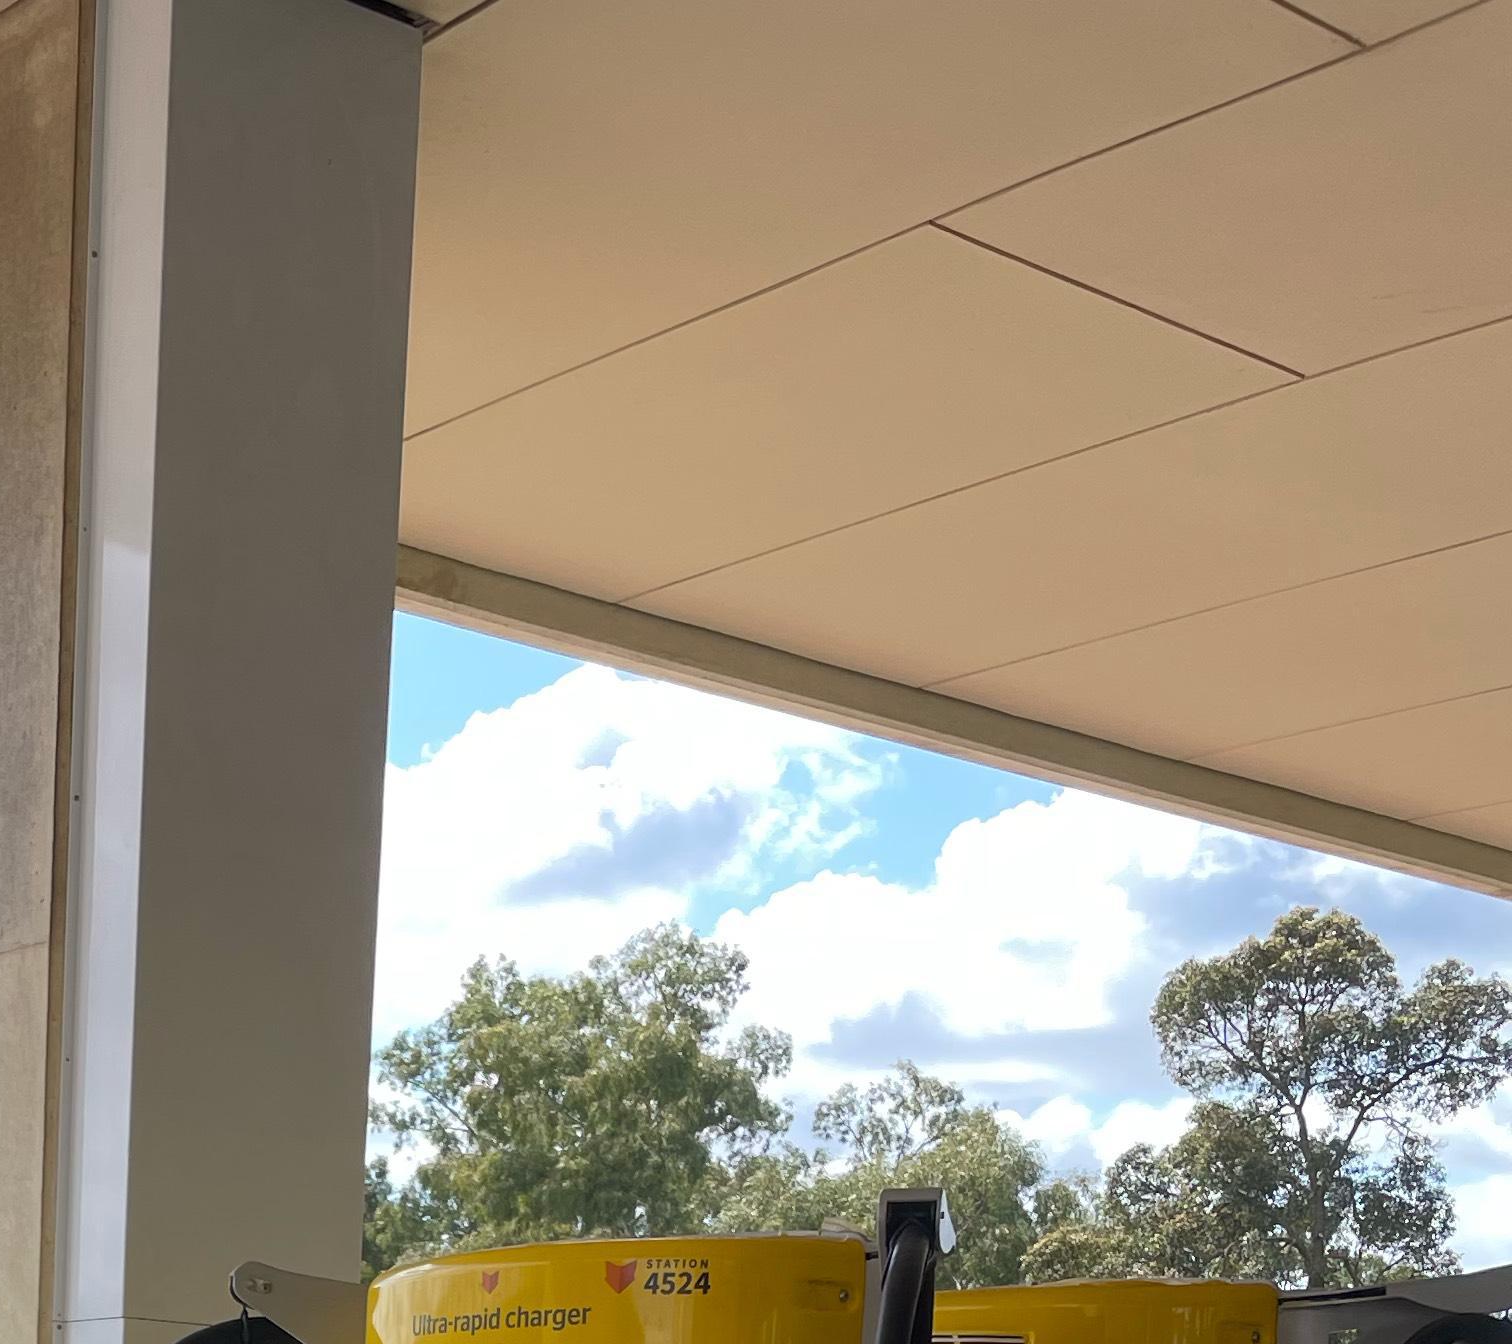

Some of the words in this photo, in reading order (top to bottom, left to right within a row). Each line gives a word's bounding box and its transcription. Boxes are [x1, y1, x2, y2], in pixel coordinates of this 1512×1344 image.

[645, 1258, 710, 1270] STATION
[644, 1271, 711, 1296] 4524
[412, 1307, 501, 1336] Ultra-rapid
[504, 1304, 592, 1332] charger
